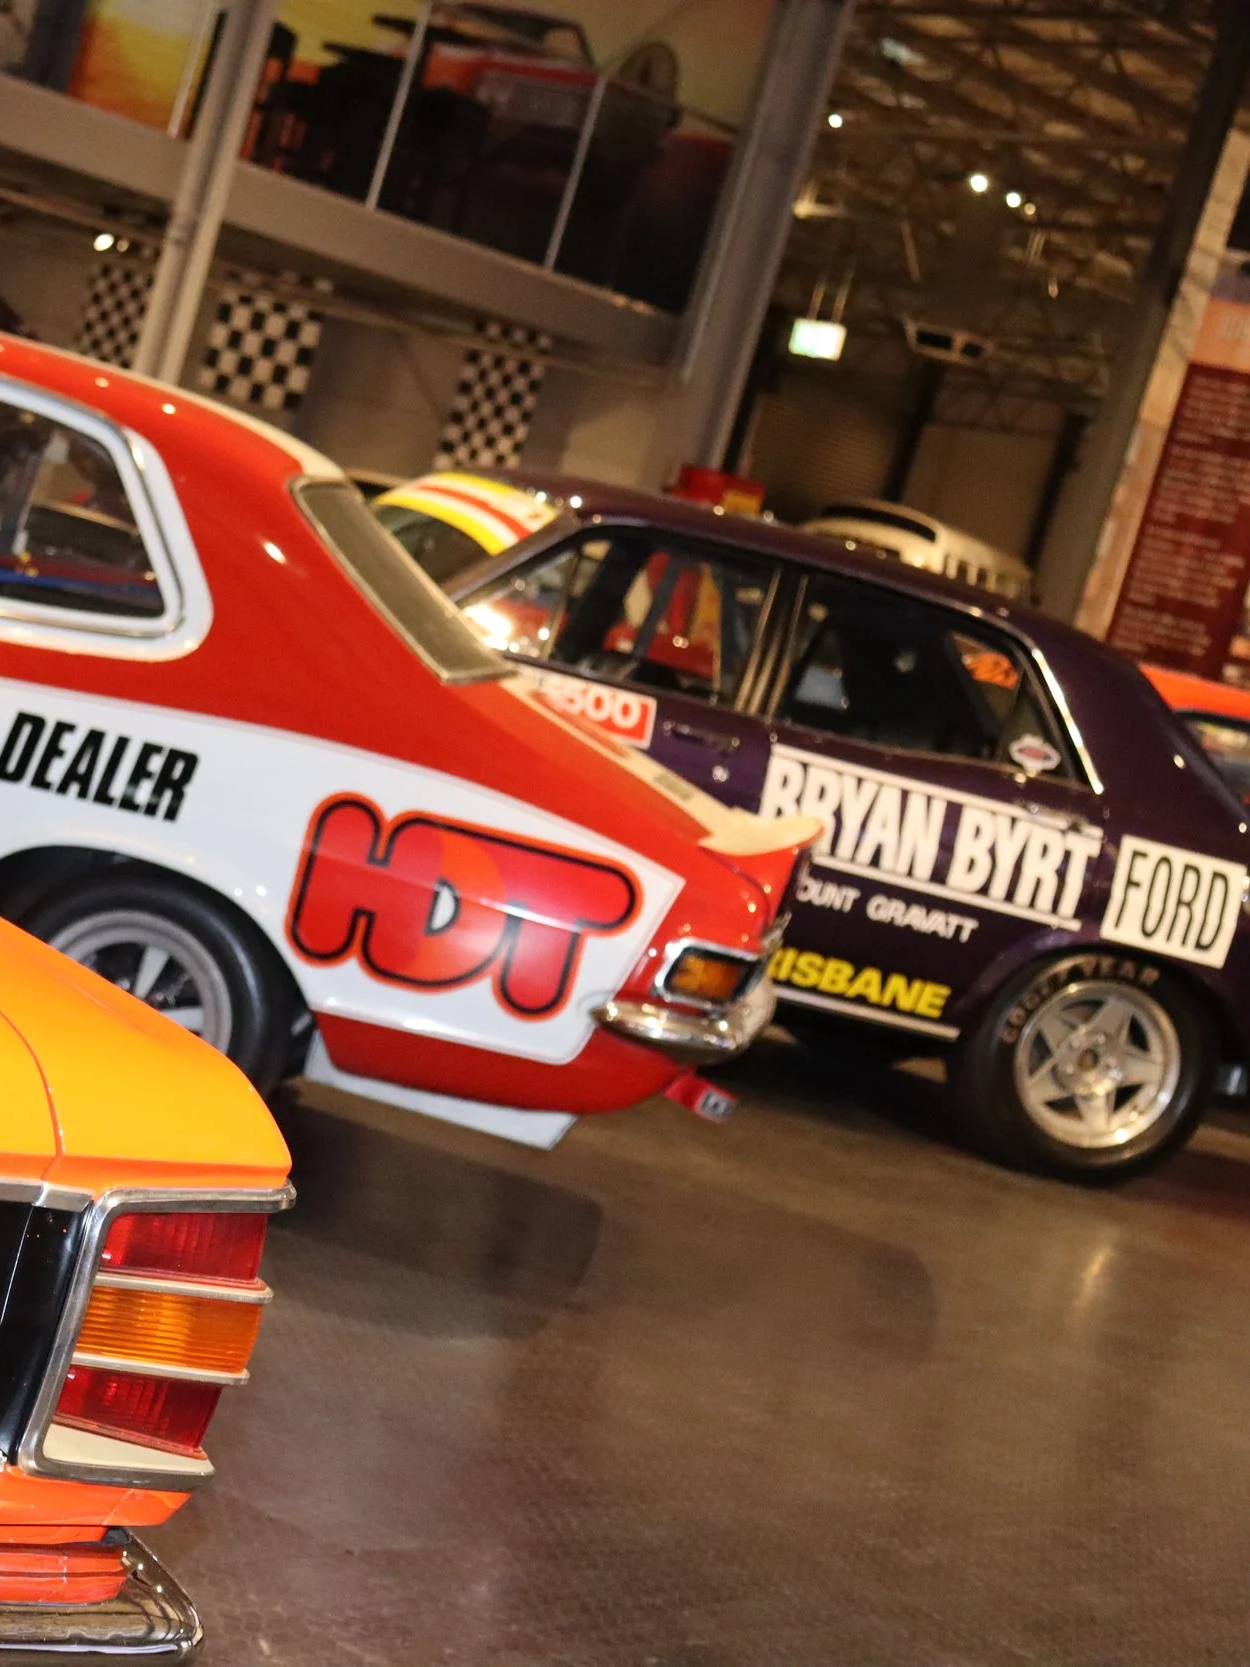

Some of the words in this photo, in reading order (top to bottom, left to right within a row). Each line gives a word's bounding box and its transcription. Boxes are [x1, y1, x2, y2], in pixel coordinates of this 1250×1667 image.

[760, 755, 948, 883] BRYAN
[947, 804, 1103, 920] BYRT
[1114, 849, 1229, 951] FORD
[287, 793, 641, 1020] HDT
[866, 894, 980, 943] GRAVATT
